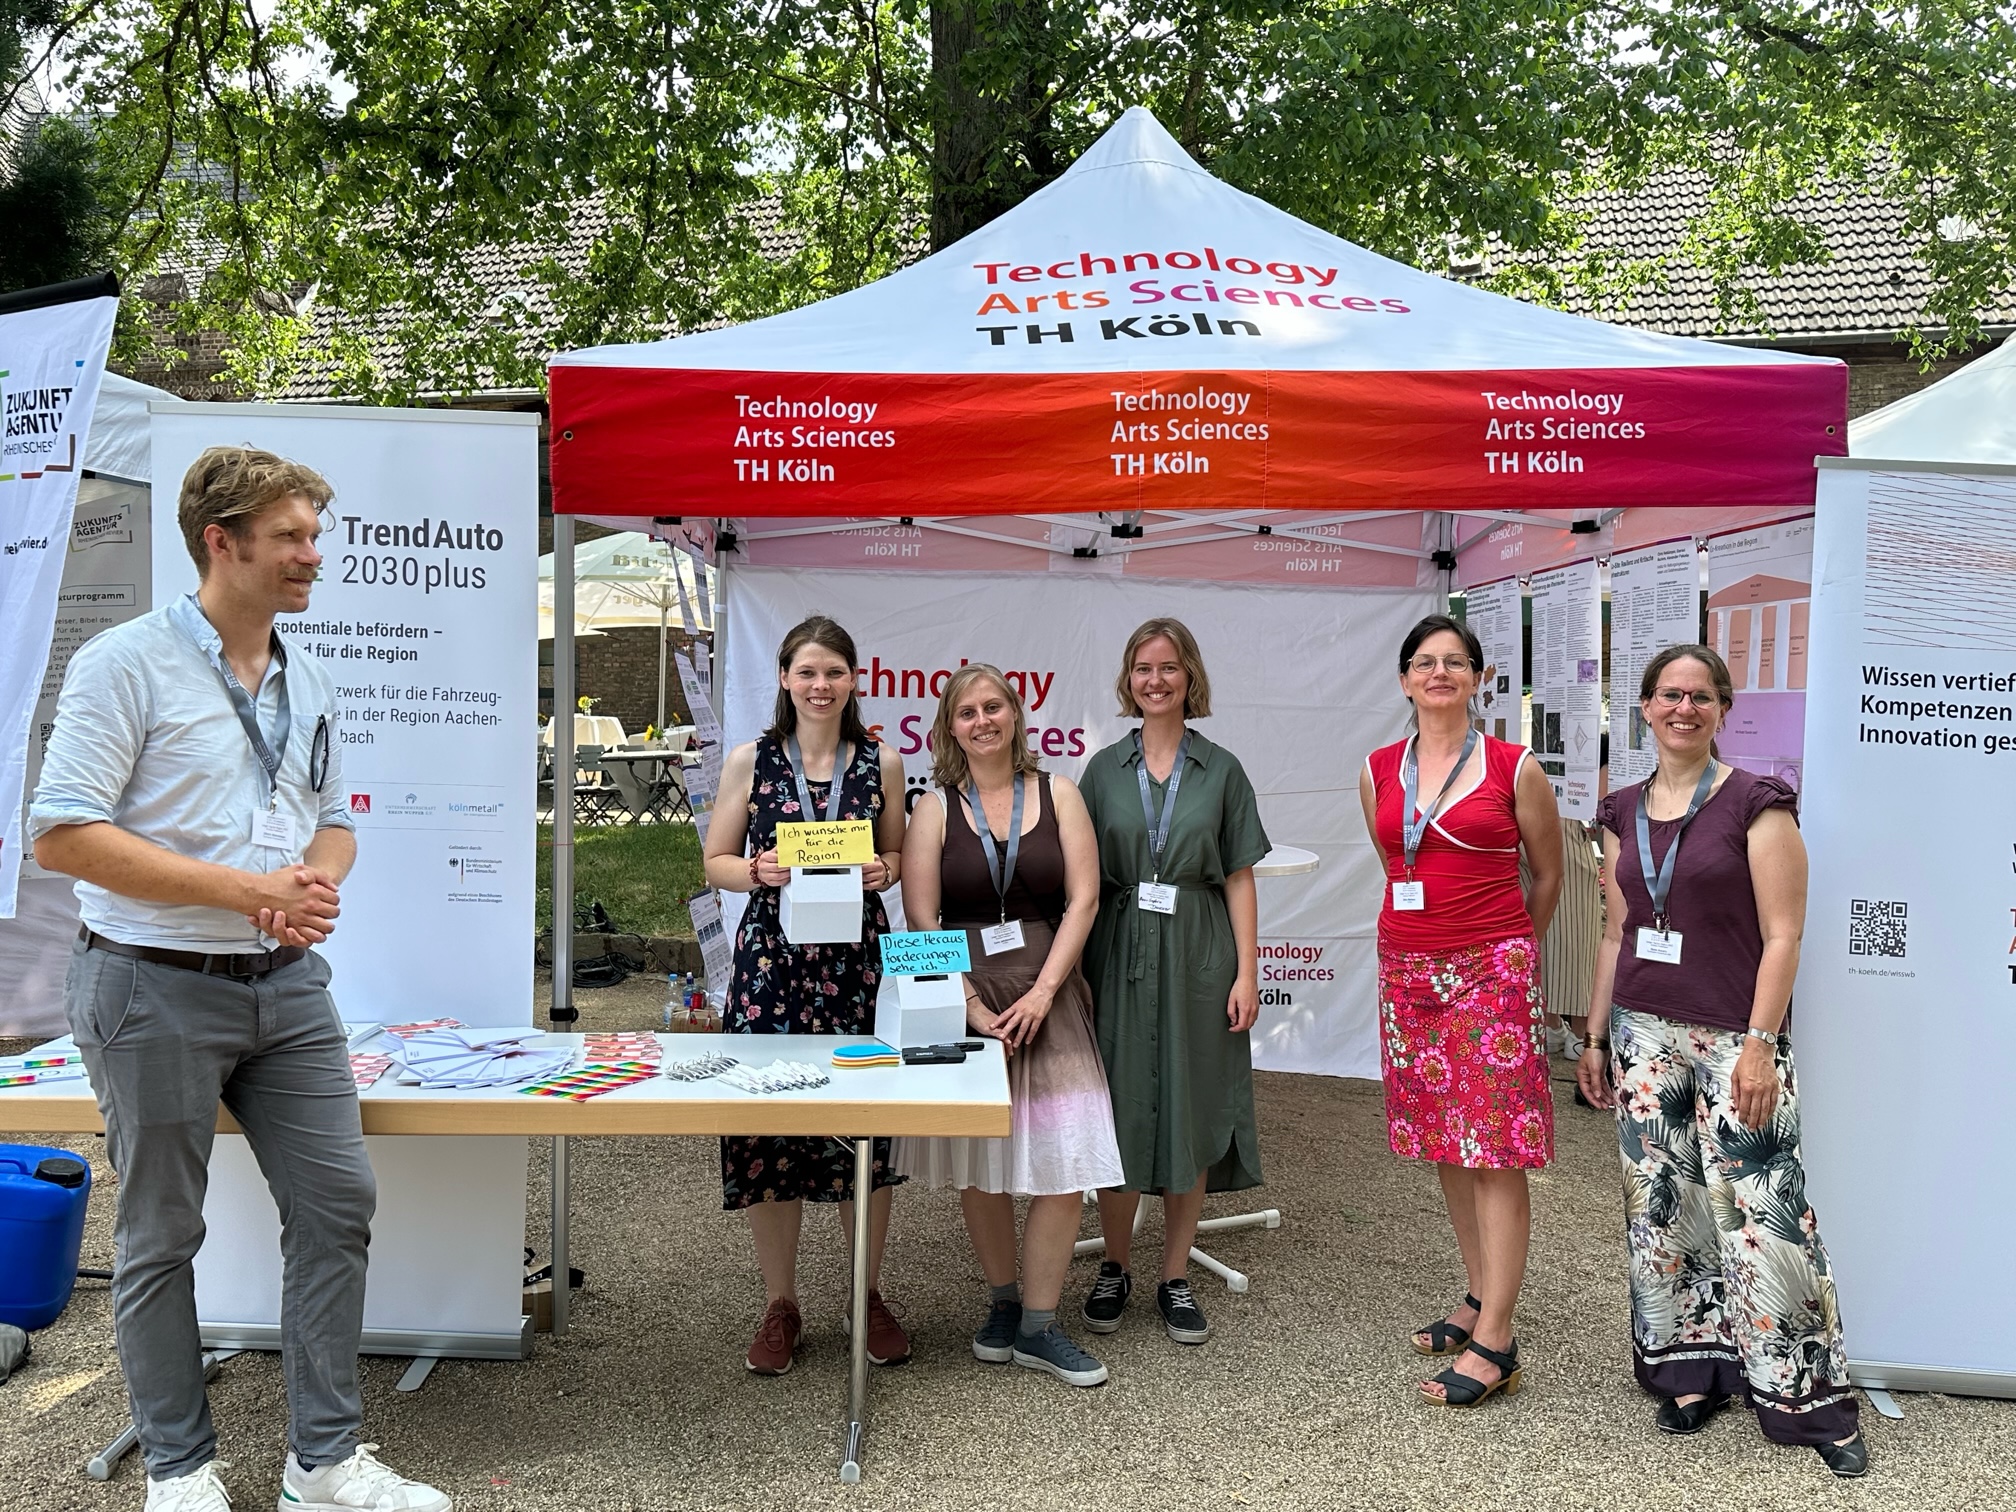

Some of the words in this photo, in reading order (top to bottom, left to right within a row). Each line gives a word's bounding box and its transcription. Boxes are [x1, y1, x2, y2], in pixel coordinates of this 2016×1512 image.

[973, 247, 1339, 287] Technology
[976, 289, 1110, 316] Arts
[1129, 279, 1411, 314] Sciences
[976, 322, 1074, 346] TH
[1100, 312, 1262, 340] Köln
[735, 395, 878, 424] Technology
[1111, 386, 1251, 416] Technology
[1482, 388, 1624, 416] Technology
[734, 426, 785, 448] Arts
[791, 425, 896, 449] Sciences
[1111, 420, 1160, 443] Arts
[1166, 418, 1270, 442] Sciences
[1486, 418, 1535, 441] Arts
[1542, 417, 1646, 441] Sciences
[734, 460, 770, 482] TH
[777, 457, 835, 482] Köln
[1111, 453, 1145, 476] TH
[1153, 450, 1209, 474] Köln
[1485, 452, 1520, 474] TH
[1528, 449, 1584, 474] Köln
[74, 513, 122, 529] ZUKUNFTS
[76, 522, 118, 537] AGENTUR
[58, 591, 125, 604] kturprogramm
[274, 621, 352, 637] spotentiale
[356, 621, 429, 638] befördern
[315, 643, 336, 658] für
[340, 643, 363, 659] die
[367, 644, 418, 664] Region
[1862, 665, 1936, 689] Wissen
[1942, 672, 2016, 693] vertief
[335, 684, 376, 699] zwerk
[381, 684, 401, 700] für
[405, 685, 428, 701] die
[432, 687, 502, 706] Fahrzeug-
[345, 706, 358, 721] in
[362, 707, 386, 722] der
[390, 708, 440, 726] Region
[444, 709, 502, 726] Aachen-
[1860, 694, 2013, 722] Kompetenzen
[340, 728, 374, 744] bach
[1859, 723, 1977, 749] Innovation
[449, 803, 497, 813] kölnmetall
[783, 827, 800, 839] Ich
[827, 838, 844, 846] die
[795, 849, 841, 864] Region
[882, 935, 923, 950] Diese
[924, 933, 966, 945] Heraus-
[885, 950, 961, 964] forderungen
[1256, 942, 1323, 963] nology
[889, 963, 918, 974] sehe
[1263, 965, 1335, 981] Sciences
[1257, 988, 1292, 1006] Köln
